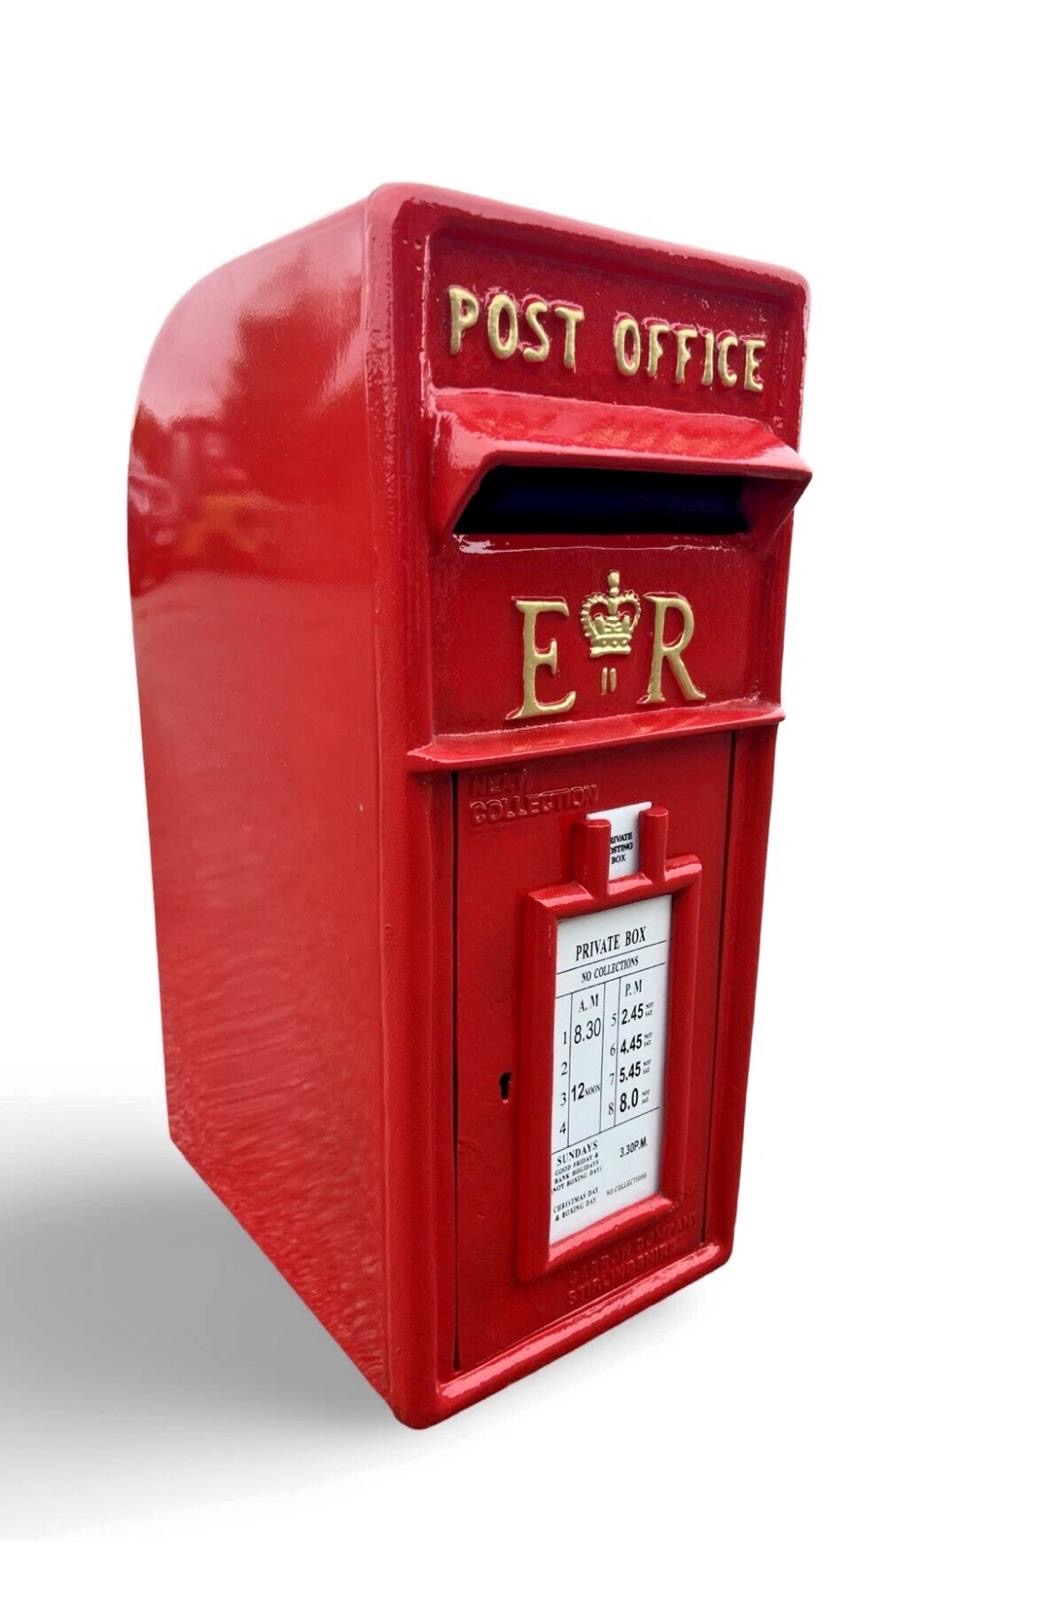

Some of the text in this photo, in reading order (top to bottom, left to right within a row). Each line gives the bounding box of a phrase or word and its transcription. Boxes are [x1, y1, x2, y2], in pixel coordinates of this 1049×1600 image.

[448, 286, 766, 392] POST OFFICE
[506, 592, 706, 720] E R
[470, 784, 599, 824] COLLECTION
[609, 842, 633, 853] OSTING
[610, 832, 633, 844] RIVATE
[611, 854, 626, 864] BOX
[575, 926, 646, 961] PRIVATE BOX
[581, 956, 639, 983] NO COLLECTIONS
[611, 1013, 616, 1027] 5
[621, 1003, 644, 1025] 2.45
[563, 1031, 567, 1045] 1
[574, 1018, 601, 1044] 8.30
[610, 1043, 615, 1056] 6
[620, 1033, 642, 1055] 4.45
[561, 1061, 567, 1075] 2
[619, 1061, 641, 1083] 5.45
[609, 1073, 615, 1086] 7
[560, 1092, 566, 1106] 3
[608, 1102, 614, 1115] 8
[619, 1088, 639, 1112] 8.0
[559, 1122, 566, 1134] 4
[556, 1140, 598, 1166] SUNDAYS
[554, 1164, 571, 1176] GOOD
[573, 1154, 592, 1168] FRIDAY
[554, 1160, 599, 1184] BANK HOLIDAYS
[566, 1172, 588, 1187] BOXING
[614, 1172, 647, 1193] COLLECTIONS
[553, 1187, 598, 1213] CHRISTMAS DAY
[562, 1202, 584, 1218] BOXING
[585, 1197, 596, 1207] DAY
